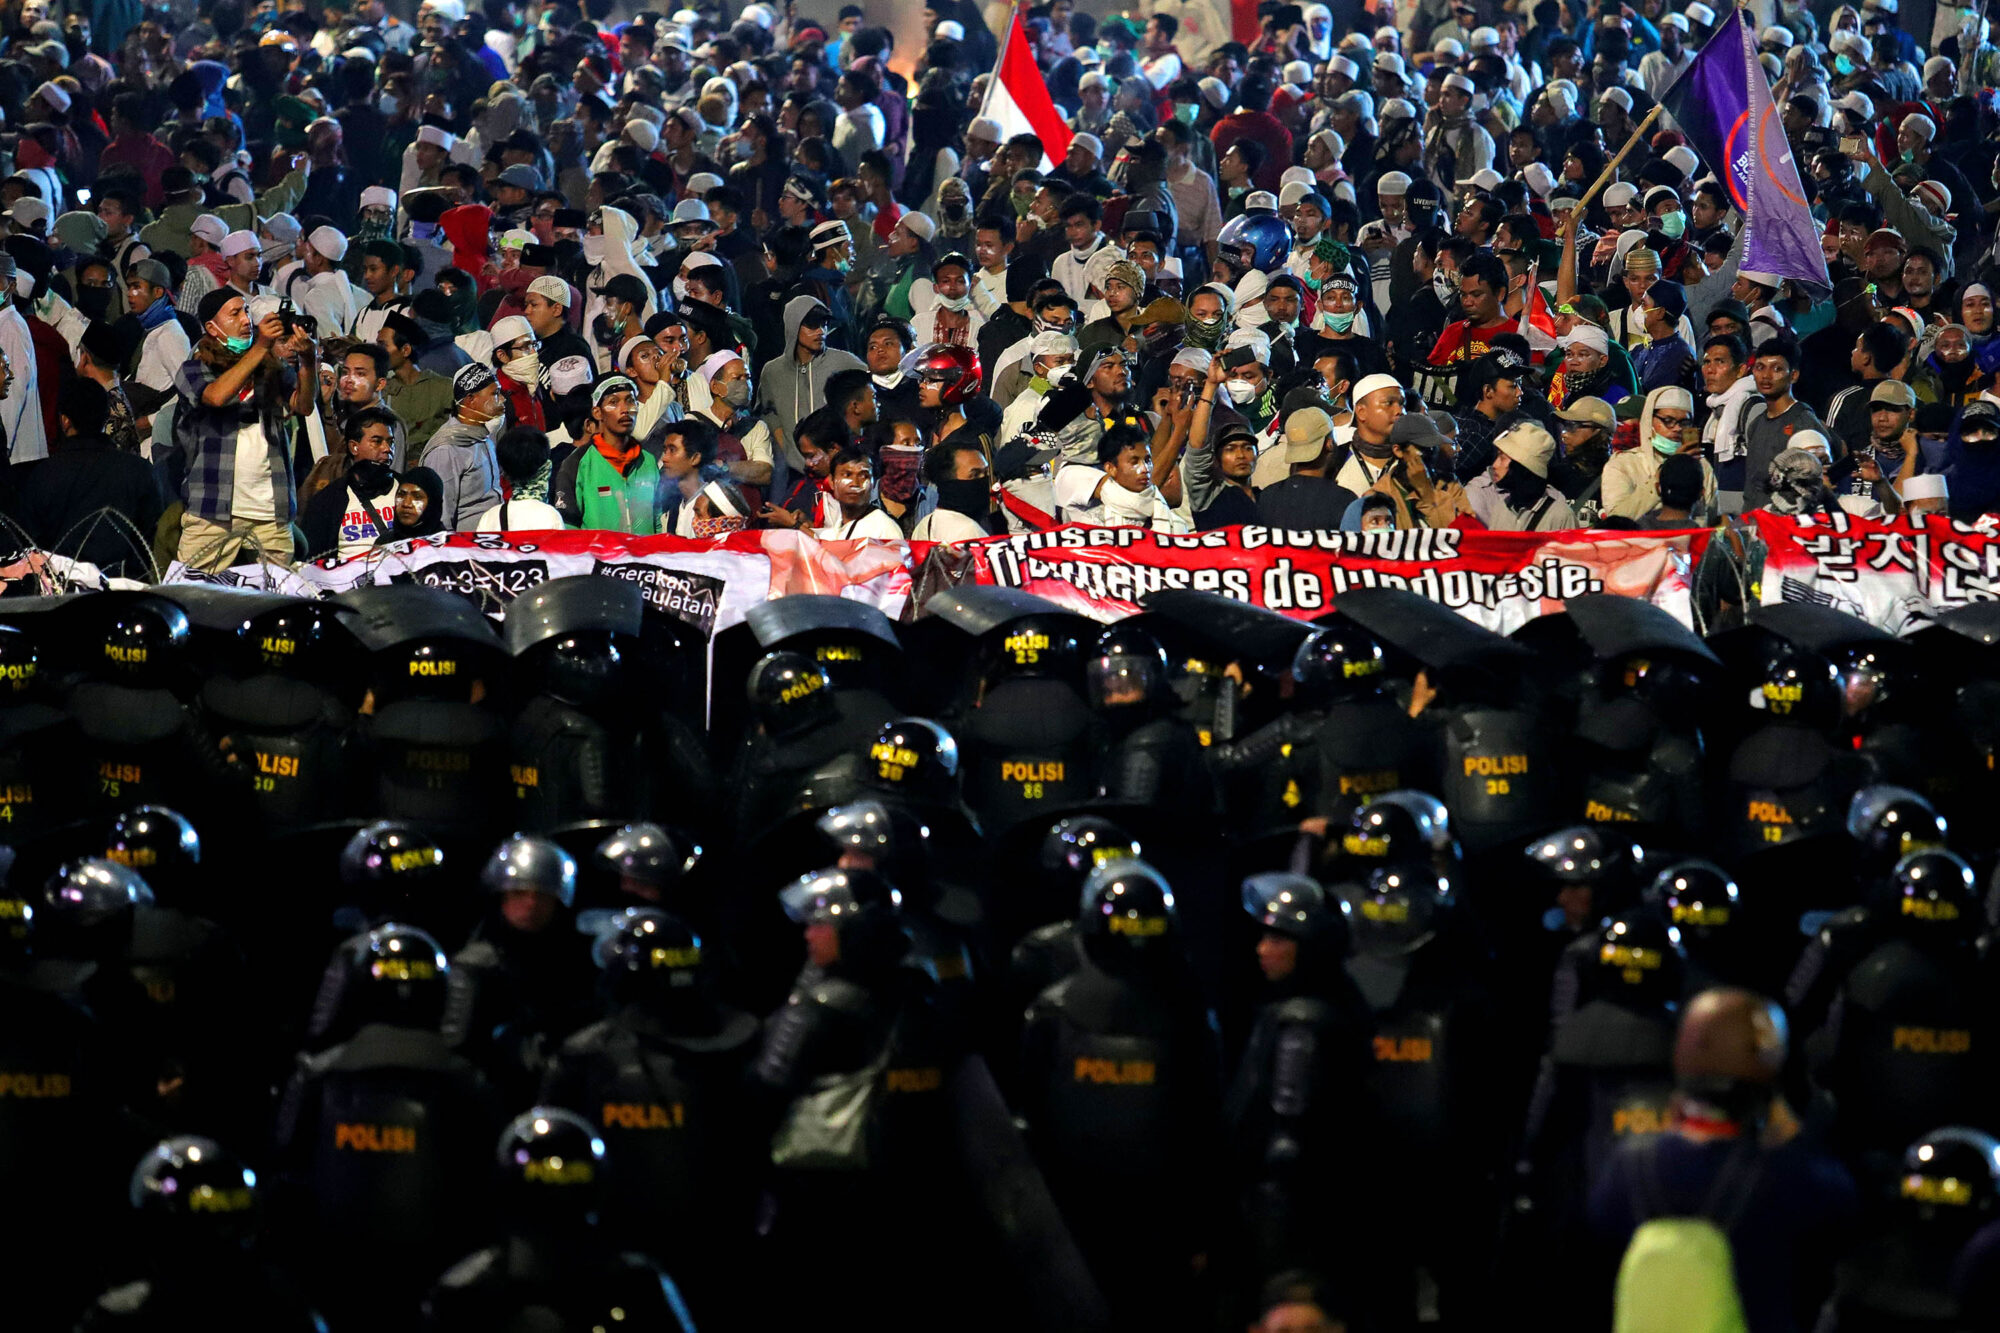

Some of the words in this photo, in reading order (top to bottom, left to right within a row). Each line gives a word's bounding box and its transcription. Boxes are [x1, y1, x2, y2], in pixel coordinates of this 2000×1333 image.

[1264, 558, 1322, 608] de
[104, 643, 147, 663] POLISI
[1004, 635, 1050, 653] POLISI
[1015, 650, 1039, 664] 25
[410, 660, 455, 676] POLISI
[1001, 761, 1065, 782] POLISI
[1463, 756, 1528, 776] POLISI
[1893, 1026, 1973, 1054] POLISI
[1074, 1056, 1156, 1085] POLISI
[333, 1122, 417, 1153] POLISI
